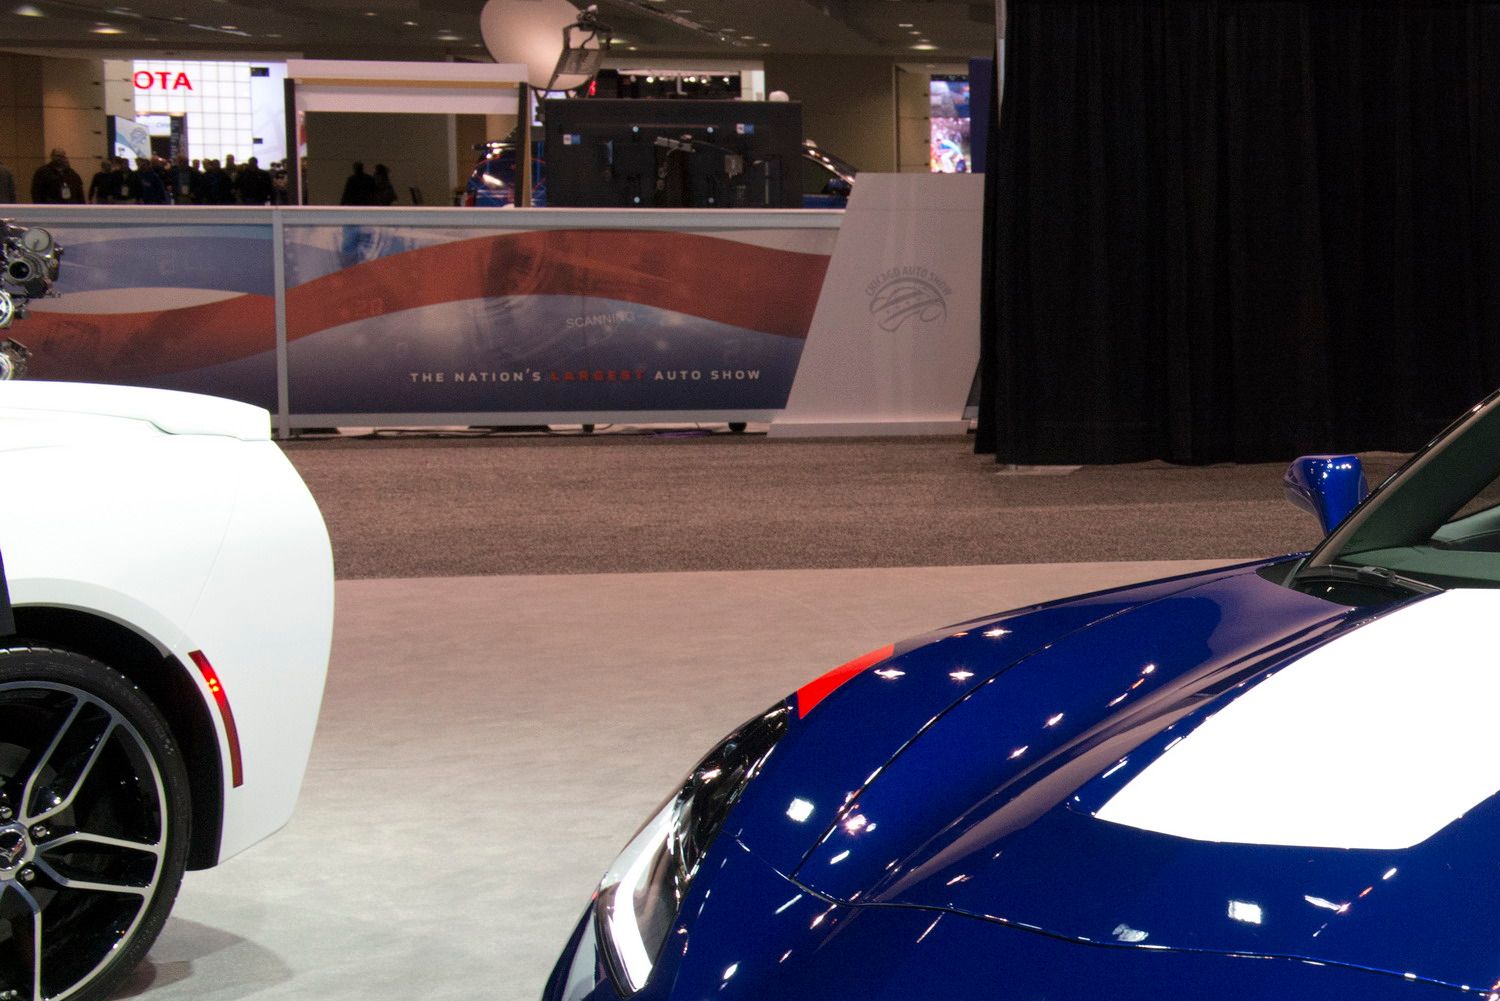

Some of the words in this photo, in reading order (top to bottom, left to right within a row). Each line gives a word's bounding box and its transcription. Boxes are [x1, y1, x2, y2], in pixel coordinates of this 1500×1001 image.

[902, 265, 929, 278] AUTO
[410, 372, 445, 383] THE
[454, 368, 542, 383] NATION'S
[551, 369, 645, 382] LARGEST
[655, 370, 701, 381] AUTO
[710, 370, 761, 381] SHOW
